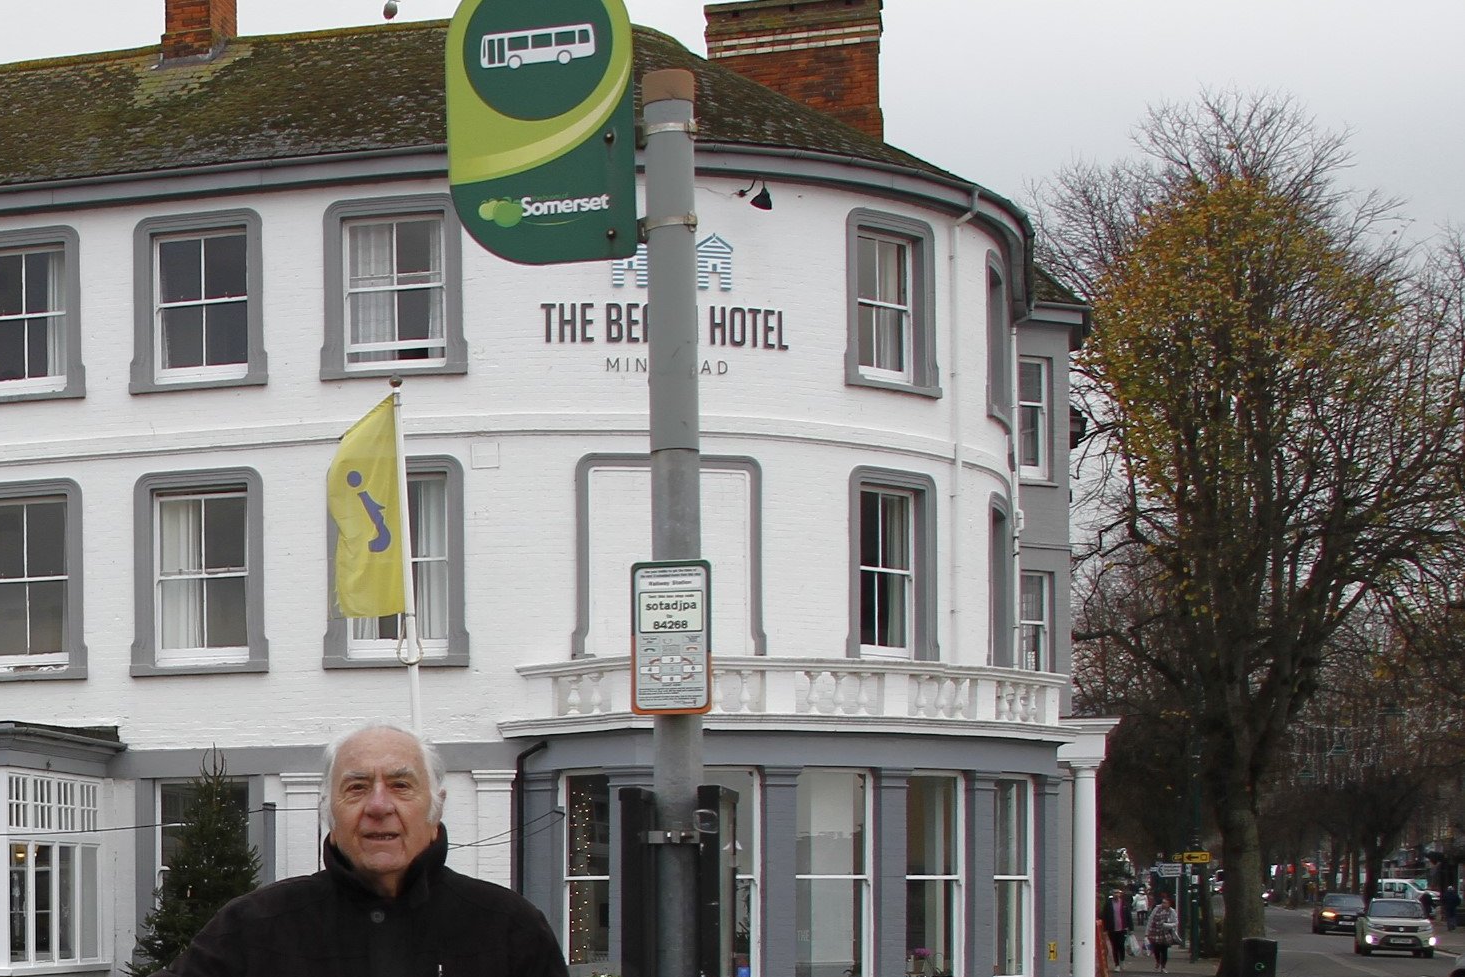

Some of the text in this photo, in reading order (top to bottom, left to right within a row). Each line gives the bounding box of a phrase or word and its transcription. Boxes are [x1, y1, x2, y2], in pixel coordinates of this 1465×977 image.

[520, 193, 610, 217] Somerset
[540, 302, 595, 343] THE
[709, 305, 789, 351] HOTEL
[606, 357, 729, 375] MINAD
[645, 600, 697, 612] sotadjpa
[653, 620, 688, 630] 84268
